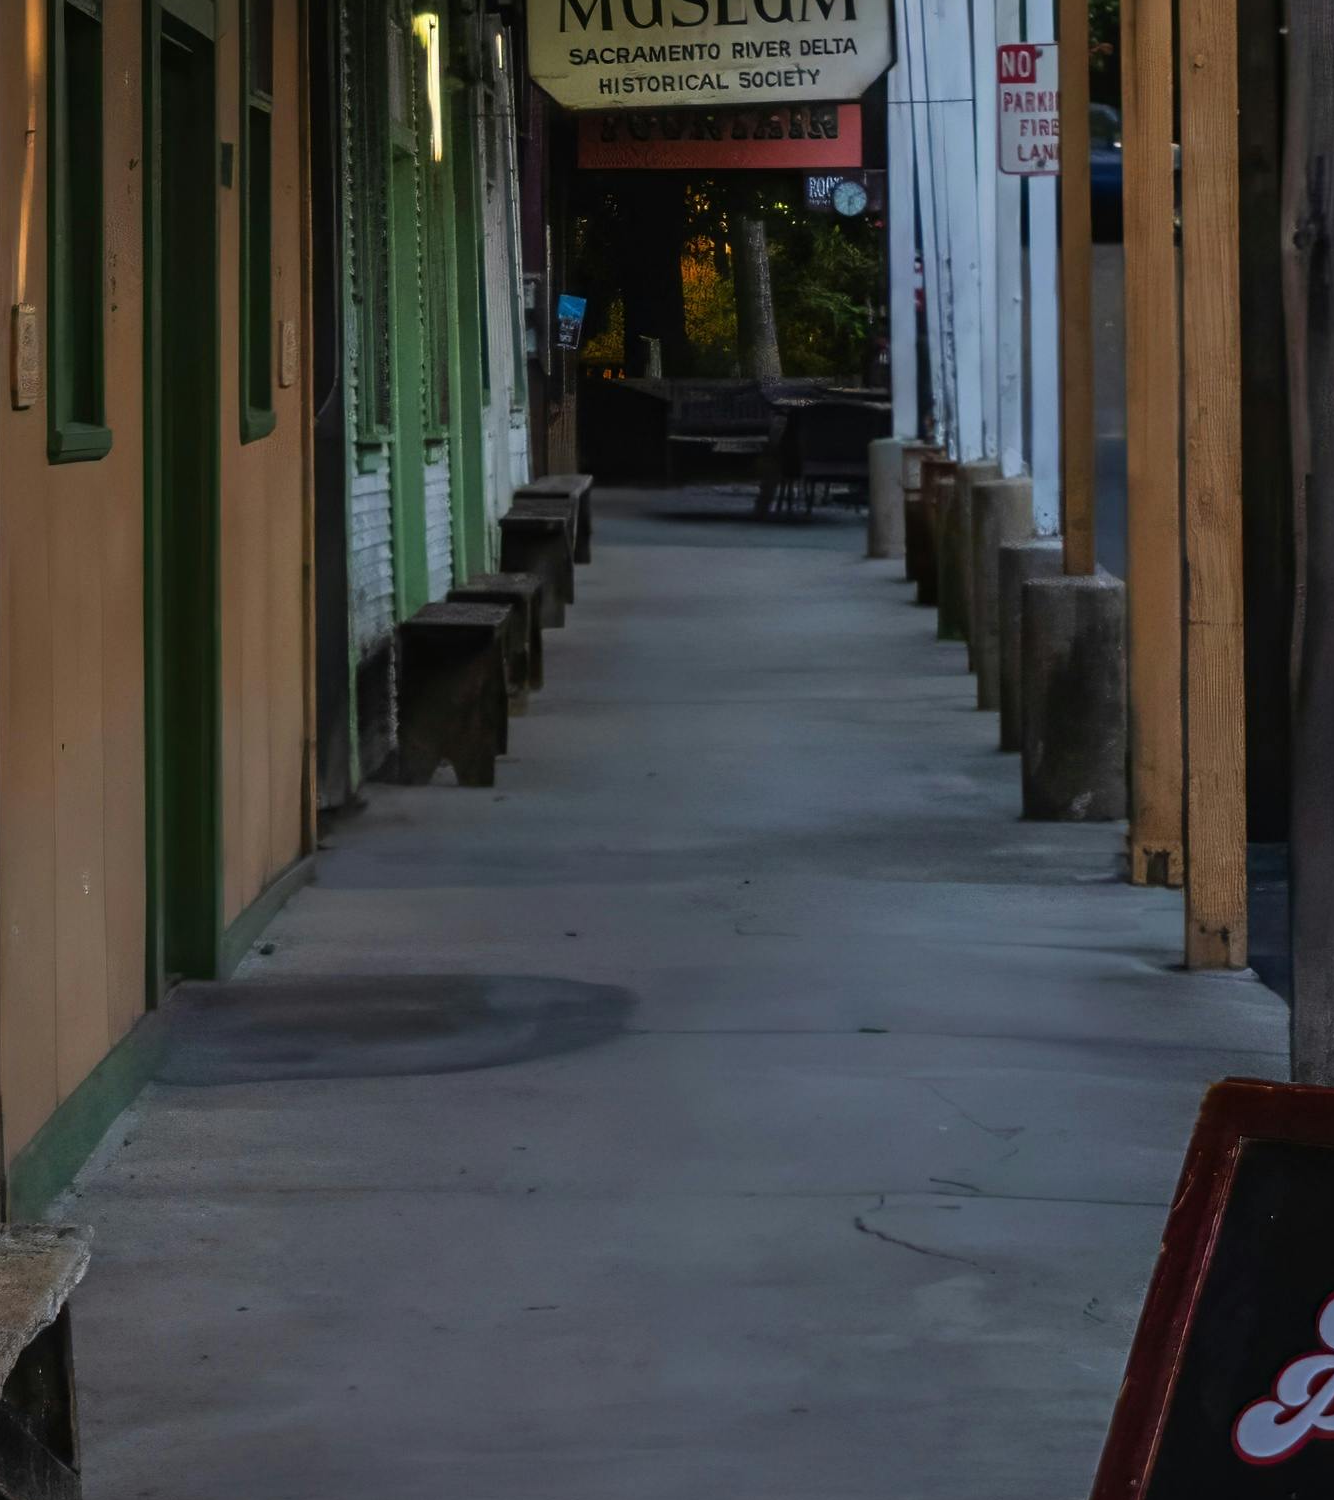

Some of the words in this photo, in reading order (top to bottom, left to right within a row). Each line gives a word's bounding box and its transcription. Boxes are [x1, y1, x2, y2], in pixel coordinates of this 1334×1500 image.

[569, 42, 721, 67] SACRAMENTO
[732, 39, 792, 59] RIVER
[799, 36, 857, 56] DELTA
[1001, 50, 1032, 78] NO
[599, 71, 729, 95] HISTORICAL
[738, 65, 822, 89] SOCIETY
[1003, 91, 1059, 113] PARKI
[1018, 143, 1059, 162] LAN
